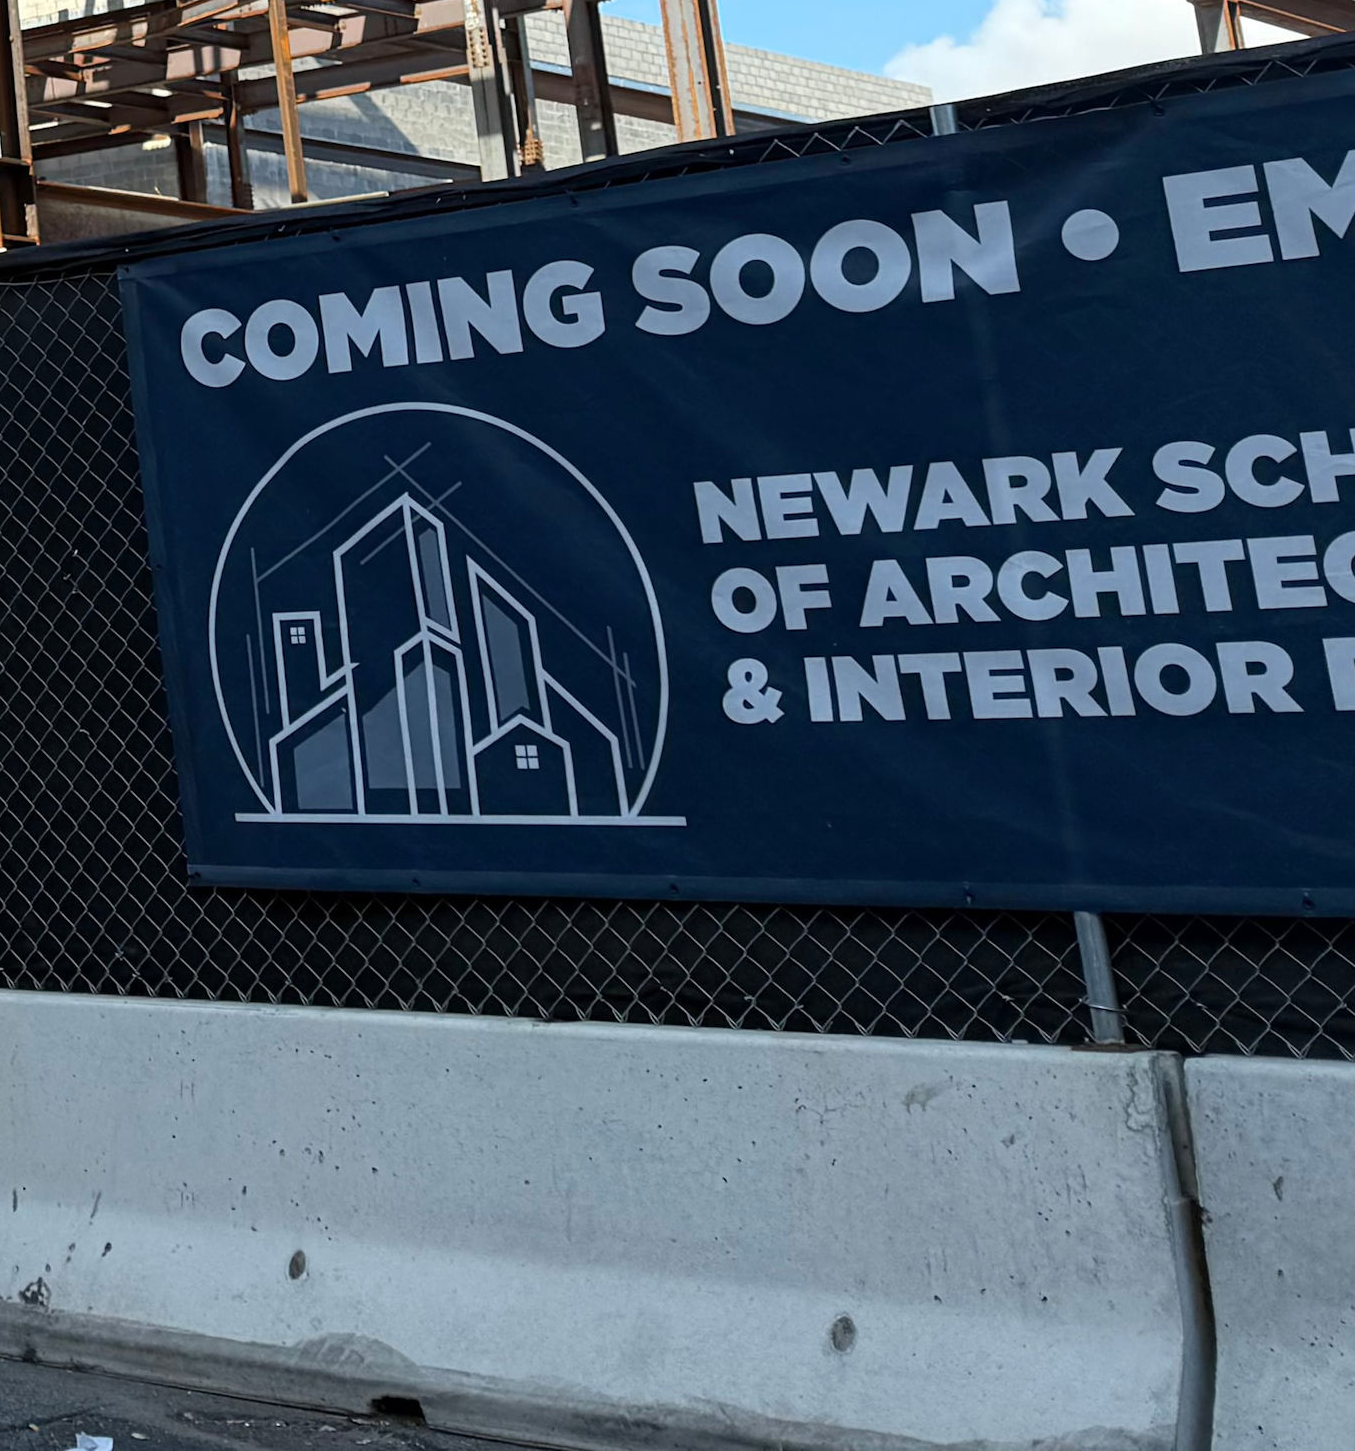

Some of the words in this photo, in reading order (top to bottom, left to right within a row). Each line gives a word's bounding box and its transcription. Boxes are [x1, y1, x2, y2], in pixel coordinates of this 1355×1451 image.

[181, 259, 605, 388] COMING
[632, 200, 1021, 335] SOON
[1162, 148, 1355, 273] EM
[693, 447, 1135, 544] NEWARK
[1151, 428, 1355, 512] SCH
[711, 563, 832, 633] OF
[722, 658, 785, 724] &
[804, 641, 1304, 722] INTERIOR
